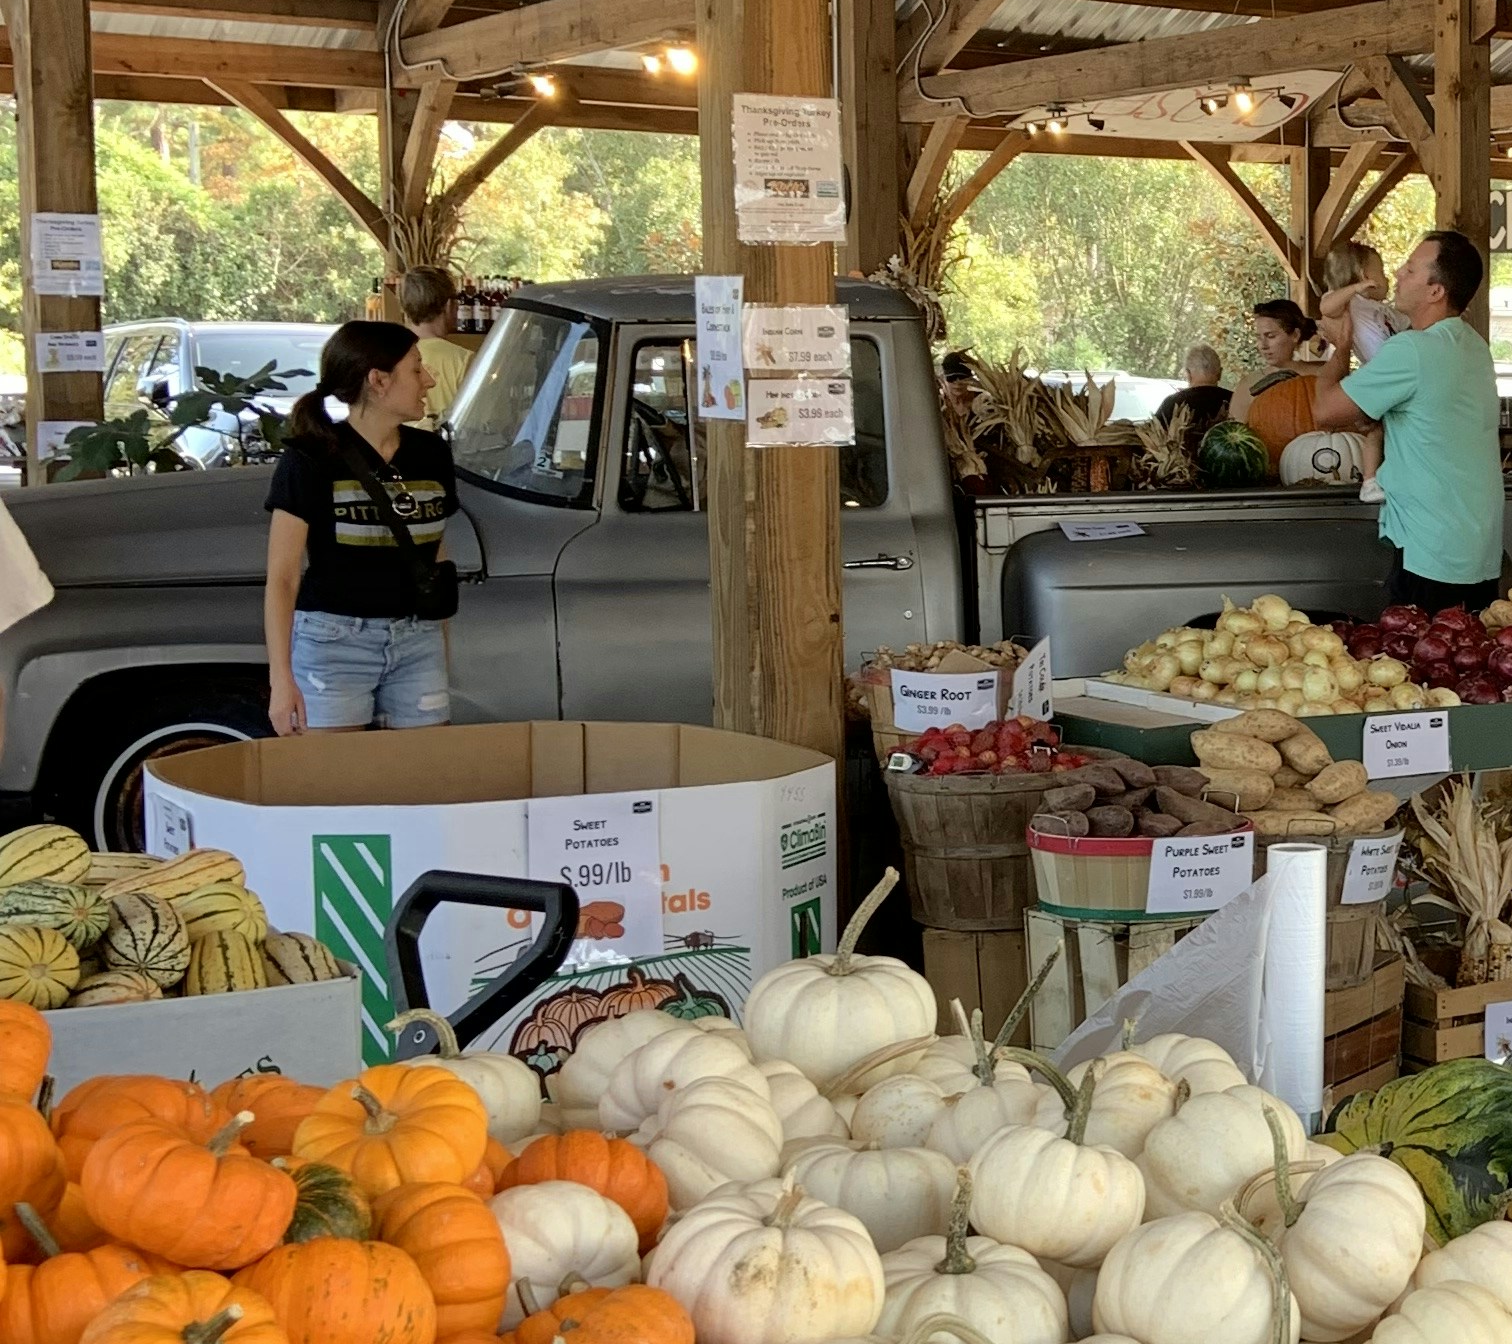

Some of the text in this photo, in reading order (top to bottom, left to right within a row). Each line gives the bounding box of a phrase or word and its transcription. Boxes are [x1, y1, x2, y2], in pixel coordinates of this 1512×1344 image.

[814, 351, 833, 362] each
[900, 685, 972, 701] GINGER ROOT
[1370, 721, 1421, 734] SWEET VIDALIA
[1385, 739, 1407, 749] ONION
[573, 819, 607, 831] SWEET
[565, 837, 619, 850] POTATOES
[1165, 843, 1229, 857] PURPLE SWEET
[1172, 866, 1220, 878] POTATOES
